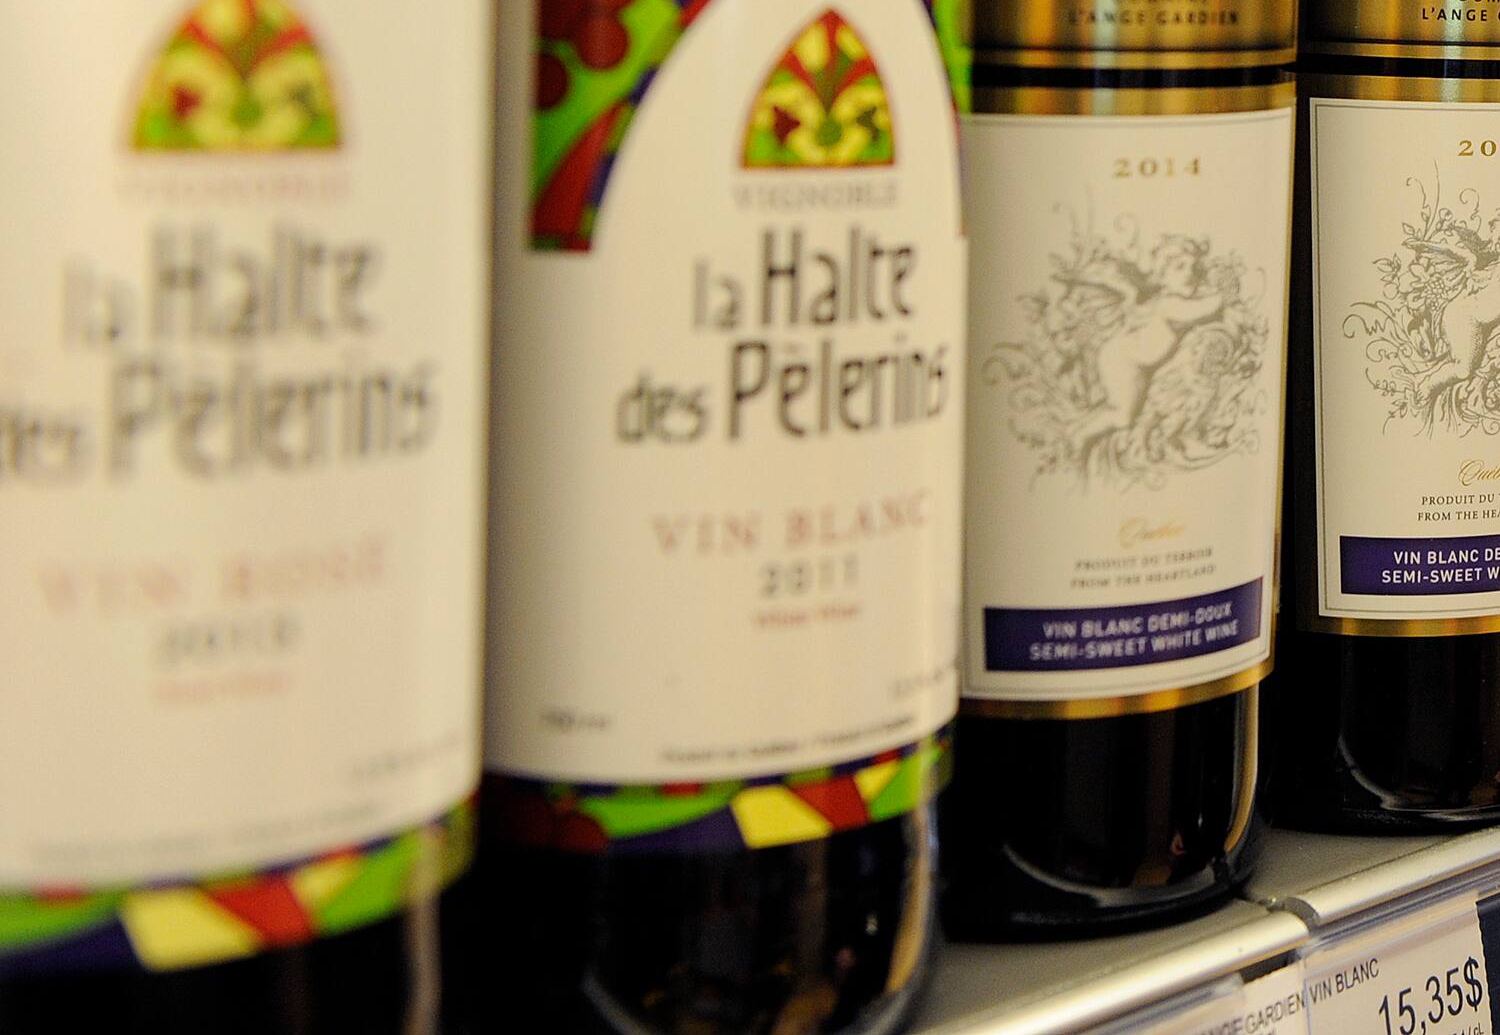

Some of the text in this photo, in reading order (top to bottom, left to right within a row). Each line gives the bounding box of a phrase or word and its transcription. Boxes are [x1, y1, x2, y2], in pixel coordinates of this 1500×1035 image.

[1069, 9, 1239, 26] L'ANGE GARDIEN
[1422, 7, 1488, 22] L'ANGE
[1113, 158, 1201, 179] 2014
[150, 219, 382, 342] Halte
[694, 226, 914, 329] la Halte
[617, 372, 705, 444] des
[1421, 494, 1475, 506] PRODUIT
[1479, 494, 1494, 504] DU
[1417, 511, 1451, 522] FROM
[1455, 510, 1479, 521] THE
[1393, 550, 1421, 565] VIN
[1427, 548, 1480, 565] BLANC
[1381, 567, 1483, 585] SEMI-SWEET
[1042, 600, 1234, 640] VIN BLANC DEMI-DOUX
[1028, 618, 1241, 662] SEMI-SWEET WHITE WINE
[1244, 992, 1306, 1034] GARDIEN
[1309, 972, 1333, 1004] VIN
[1335, 958, 1381, 995] BLANC
[1379, 956, 1483, 1035] 15,35$
